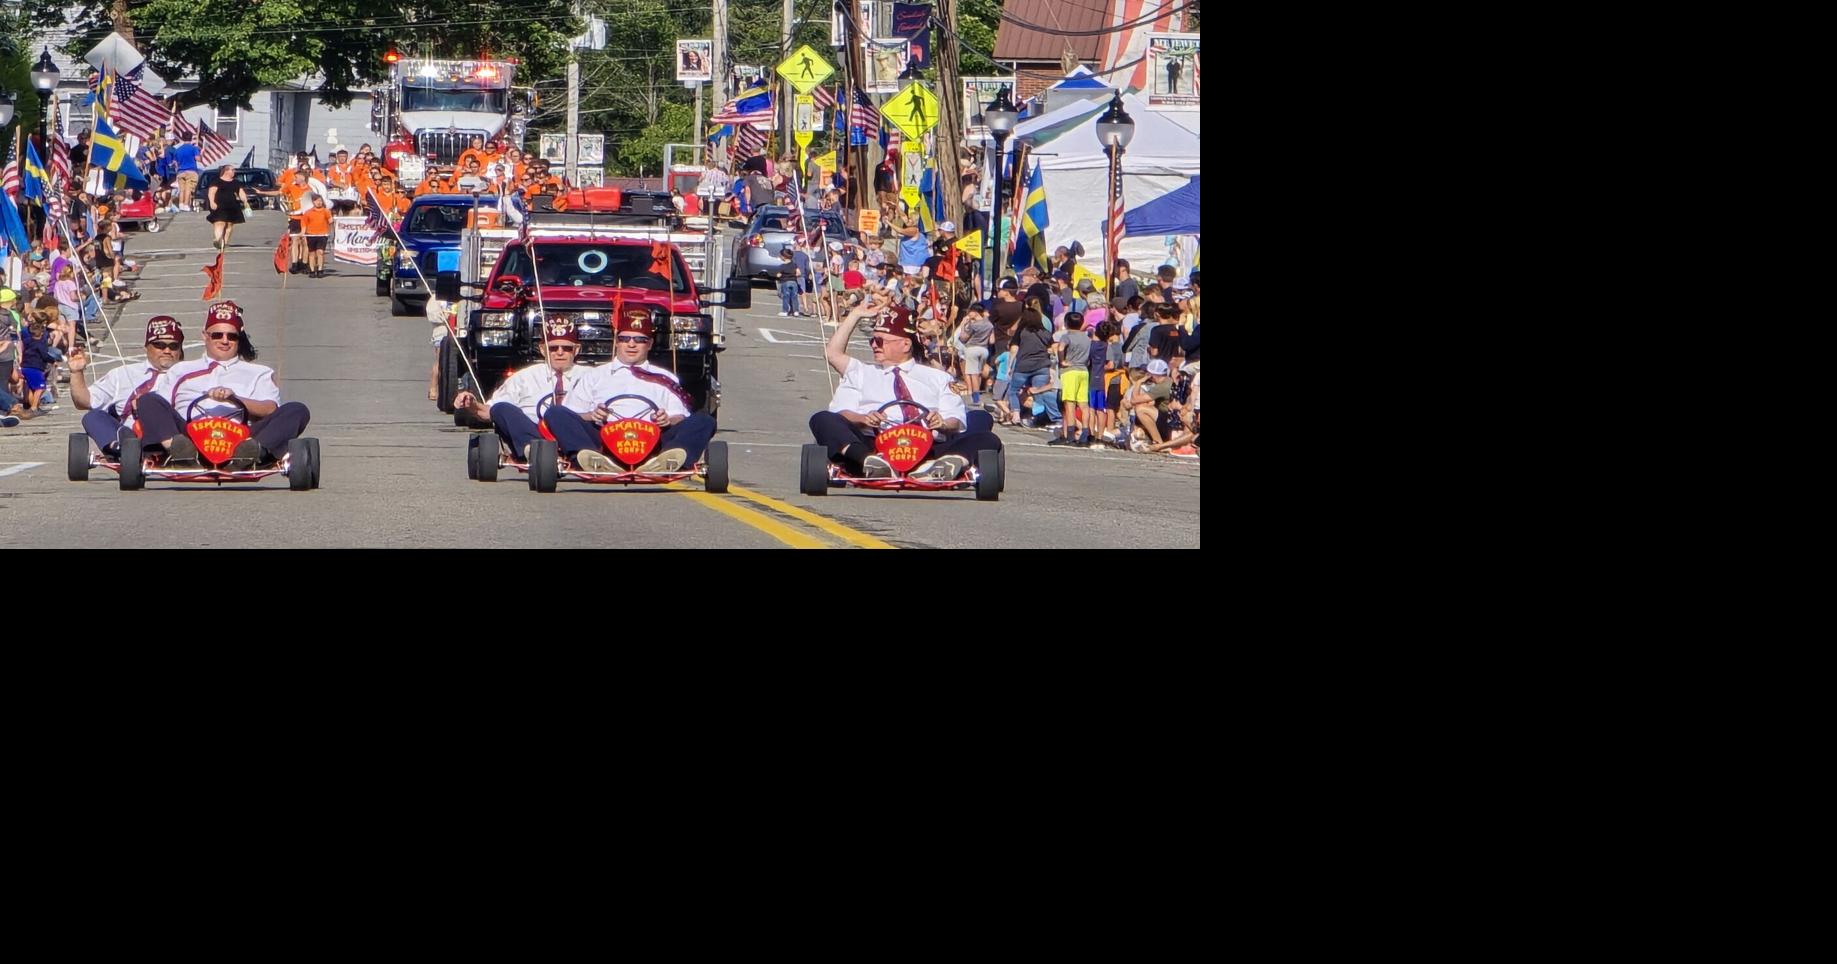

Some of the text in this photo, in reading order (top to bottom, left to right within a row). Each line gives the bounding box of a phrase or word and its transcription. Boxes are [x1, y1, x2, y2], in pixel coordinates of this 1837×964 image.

[192, 420, 243, 437] ISMAILIA
[604, 421, 655, 436] ISMAILIA
[879, 428, 928, 444] ISMAILIA
[204, 439, 233, 448] KART
[616, 440, 647, 448] KART
[888, 447, 919, 455] KART
